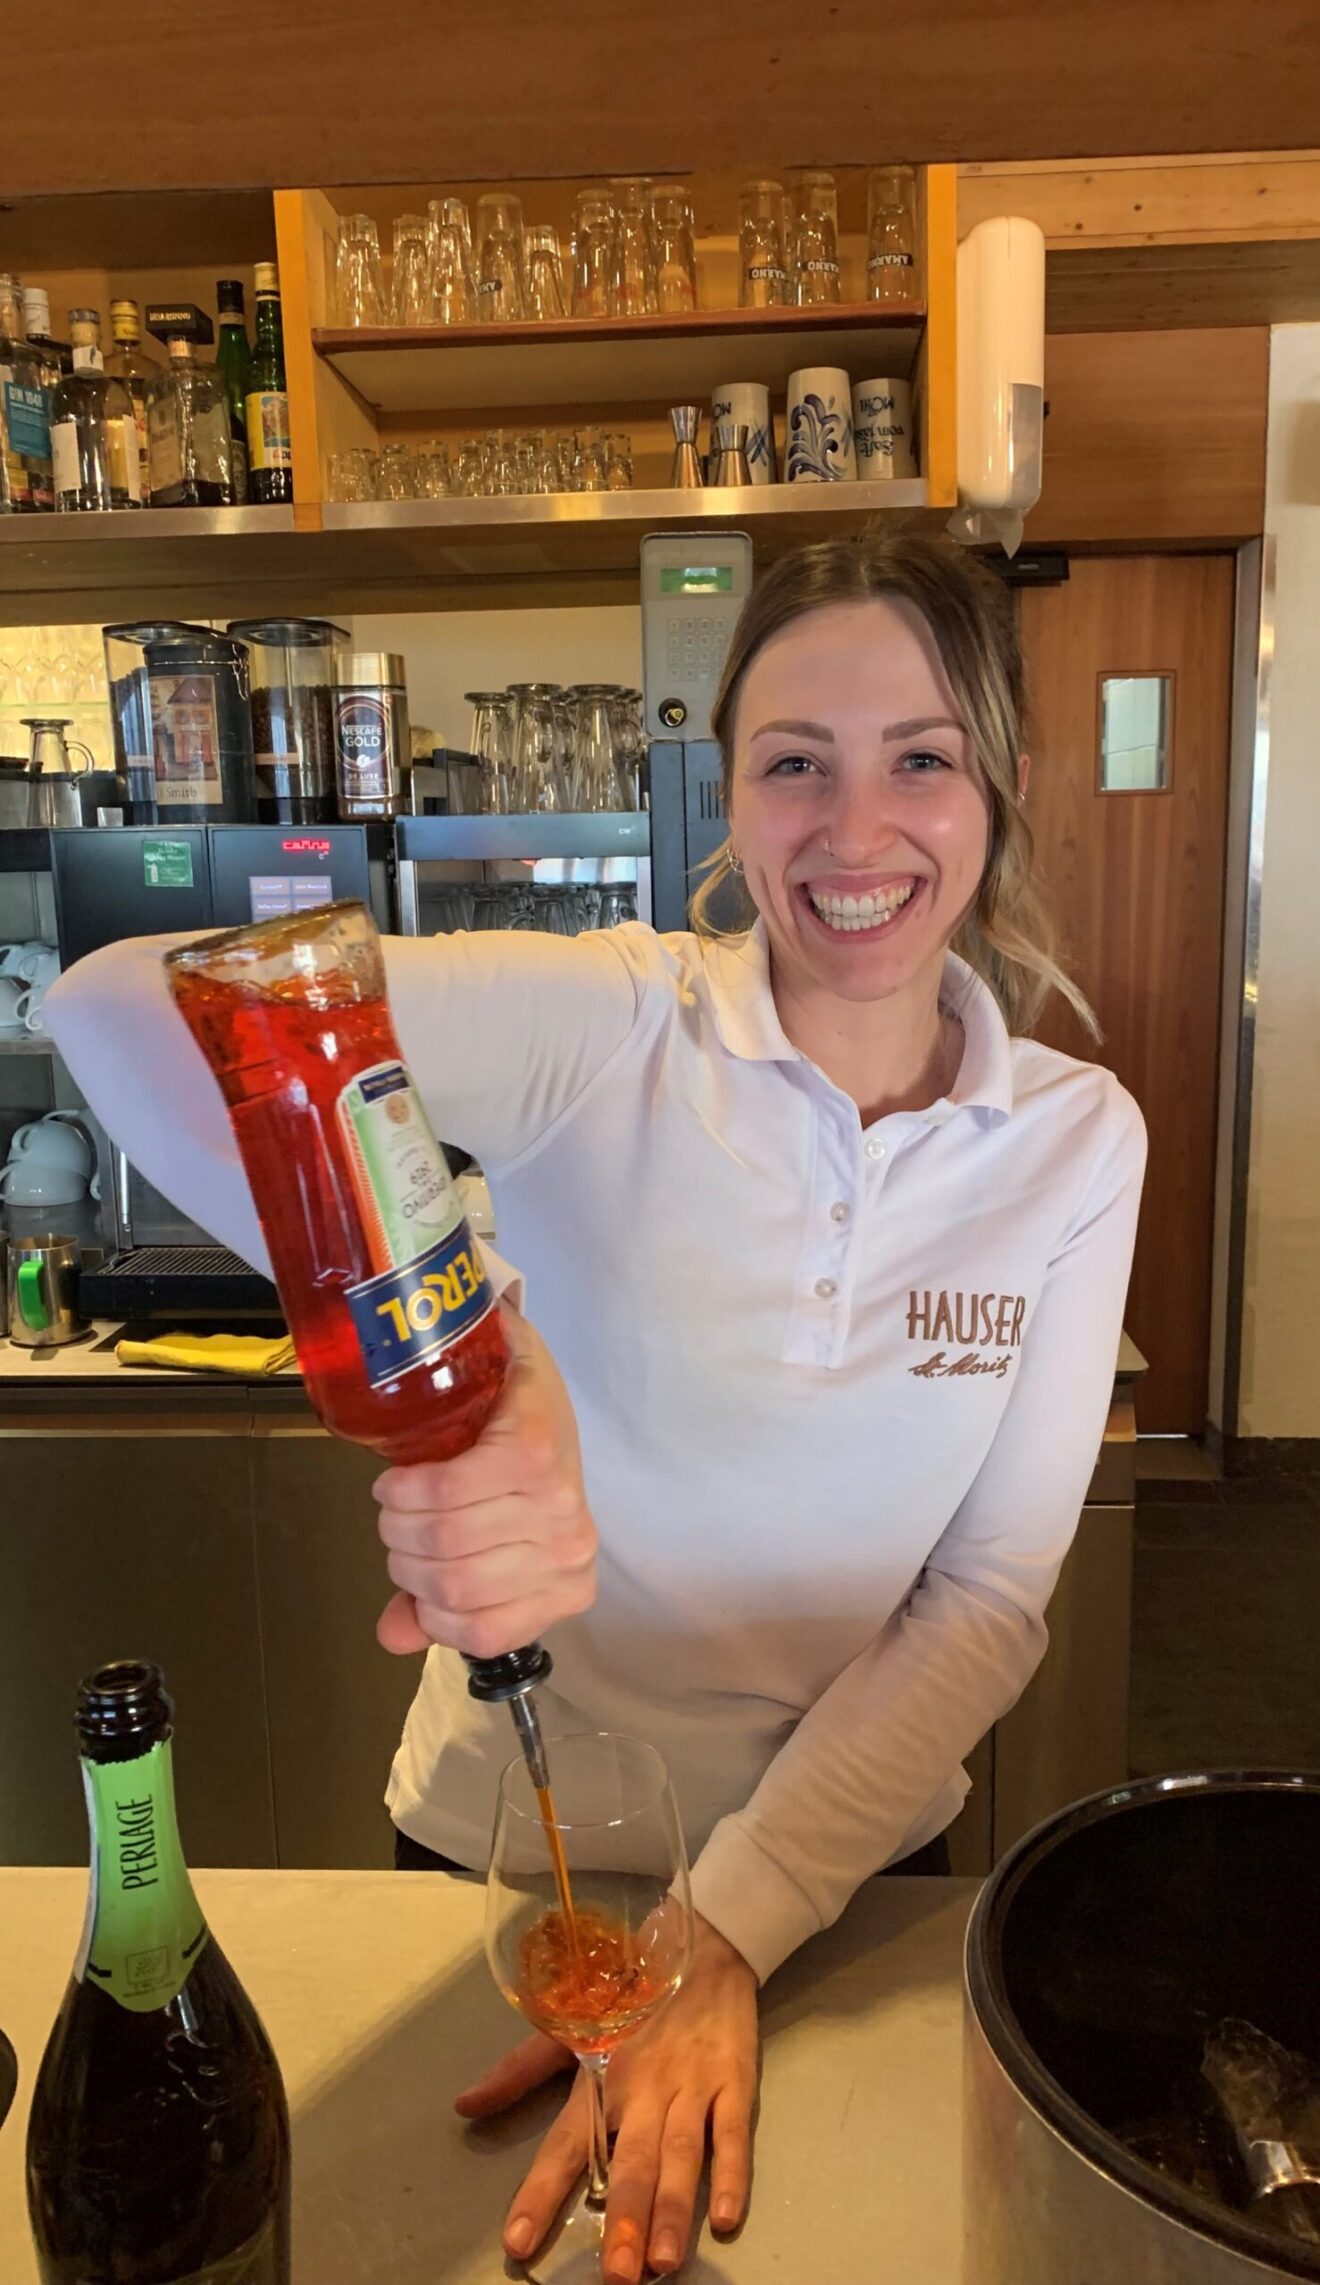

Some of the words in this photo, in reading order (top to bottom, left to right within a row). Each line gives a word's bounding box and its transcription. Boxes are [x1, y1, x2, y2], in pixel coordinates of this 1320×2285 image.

[345, 736, 381, 747] GOLD
[166, 786, 197, 798] Smith
[376, 1240, 486, 1342] PEROL
[906, 1290, 1025, 1346] HAUSER
[937, 1352, 1012, 1379] Moritz
[115, 1793, 159, 1890] PERLAGE
